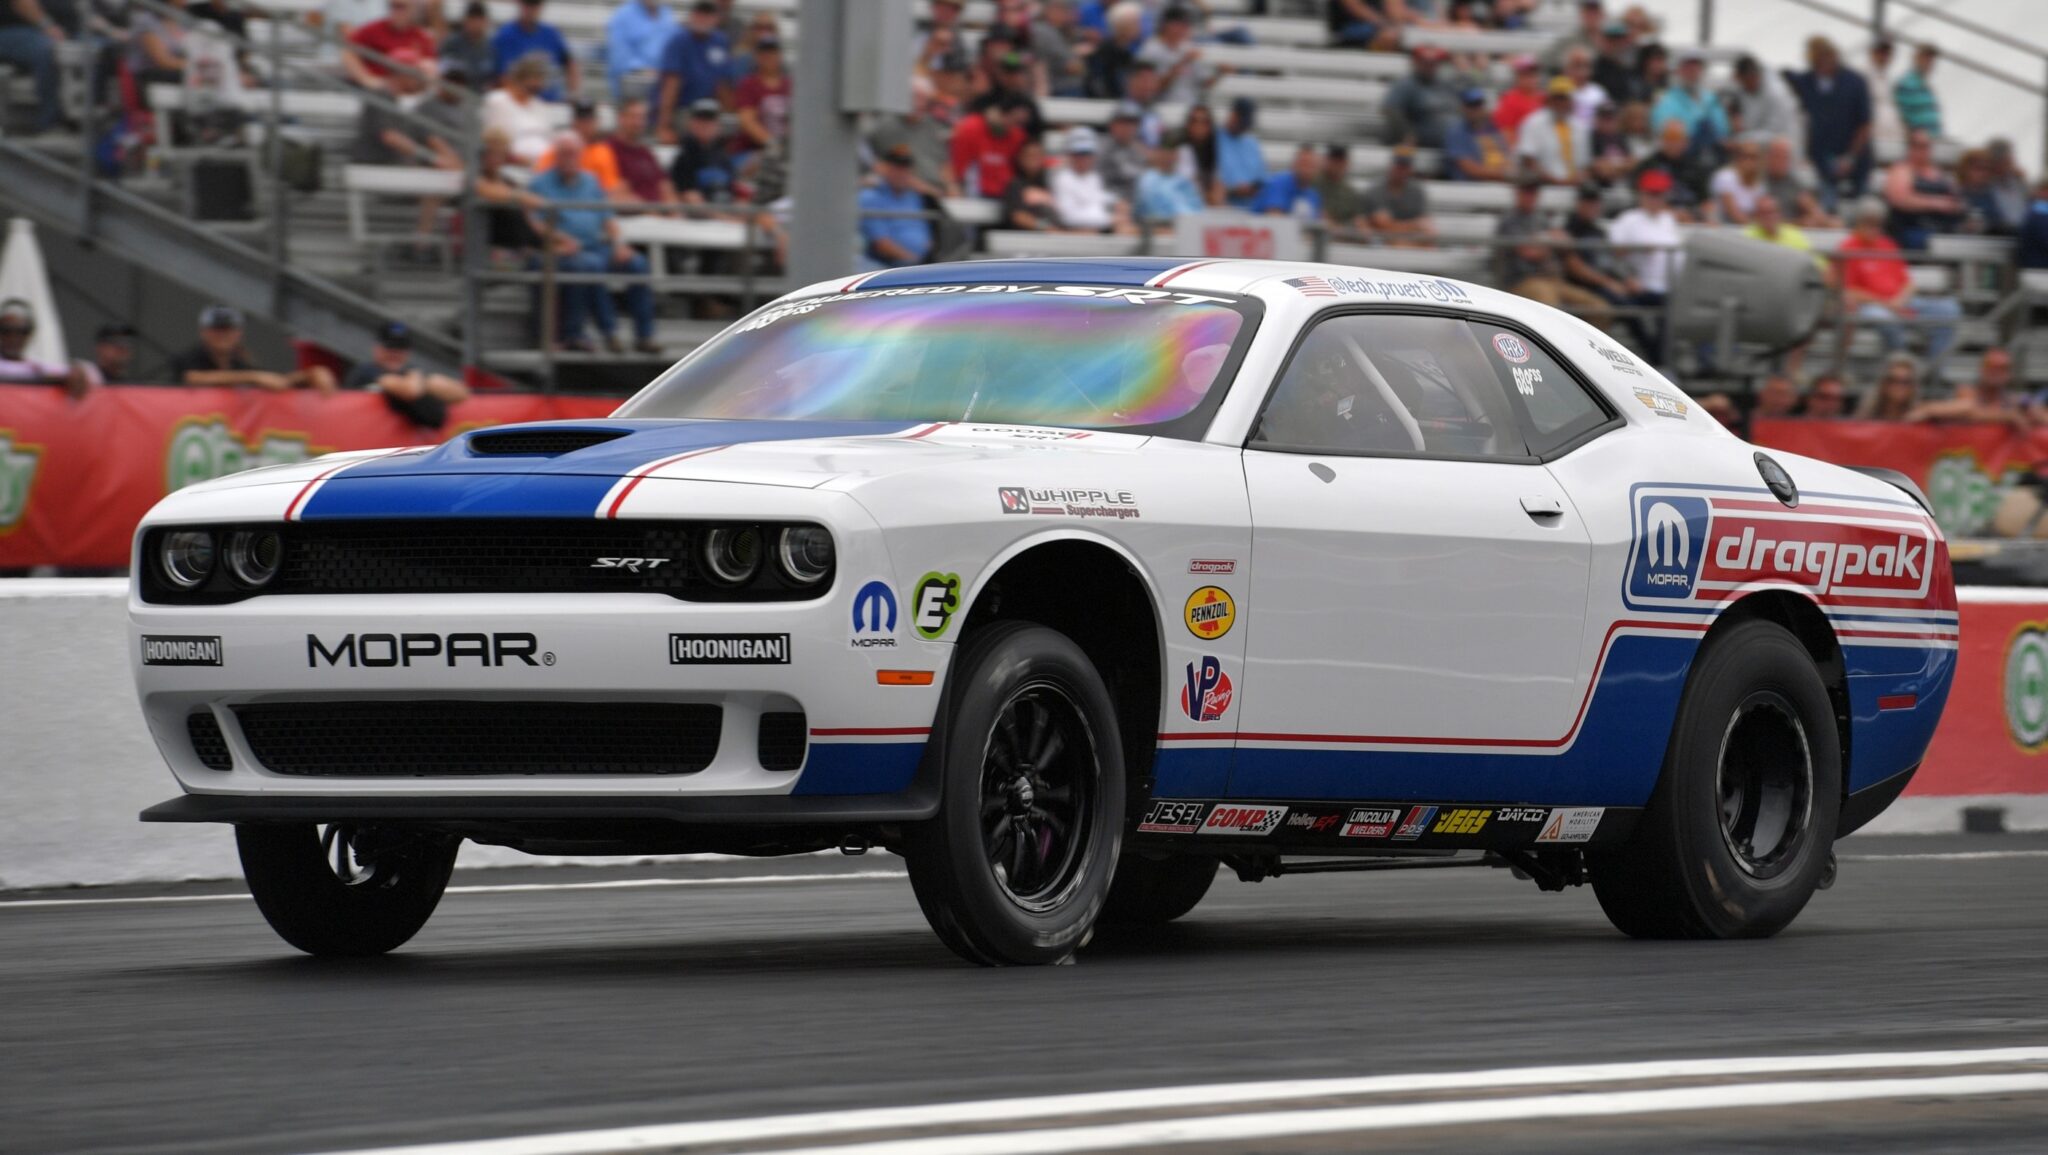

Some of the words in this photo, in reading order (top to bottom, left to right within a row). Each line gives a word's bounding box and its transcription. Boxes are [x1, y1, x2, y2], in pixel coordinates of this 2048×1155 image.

[966, 285, 1041, 293] BY
[1032, 286, 1237, 305] SRT
[1498, 338, 1525, 358] NHRA
[1028, 489, 1135, 505] WHIPPLE
[1067, 505, 1140, 519] Superchargers
[591, 557, 670, 573] SRT
[1191, 560, 1234, 573] dragpak
[1716, 527, 1922, 594] dragpak
[1647, 573, 1690, 587] MOPAR
[1191, 602, 1229, 623] PENNZOIL
[851, 639, 898, 648] MOPAR
[1186, 655, 1220, 721] VP
[1144, 802, 1204, 825] JESEL
[1206, 808, 1267, 827] COMP
[1287, 812, 1317, 830] Holley
[1349, 811, 1392, 823] LINCOLN
[1432, 809, 1493, 833] JEGS
[1496, 808, 1548, 821] DAYCO
[1351, 825, 1387, 835] WELDERS
